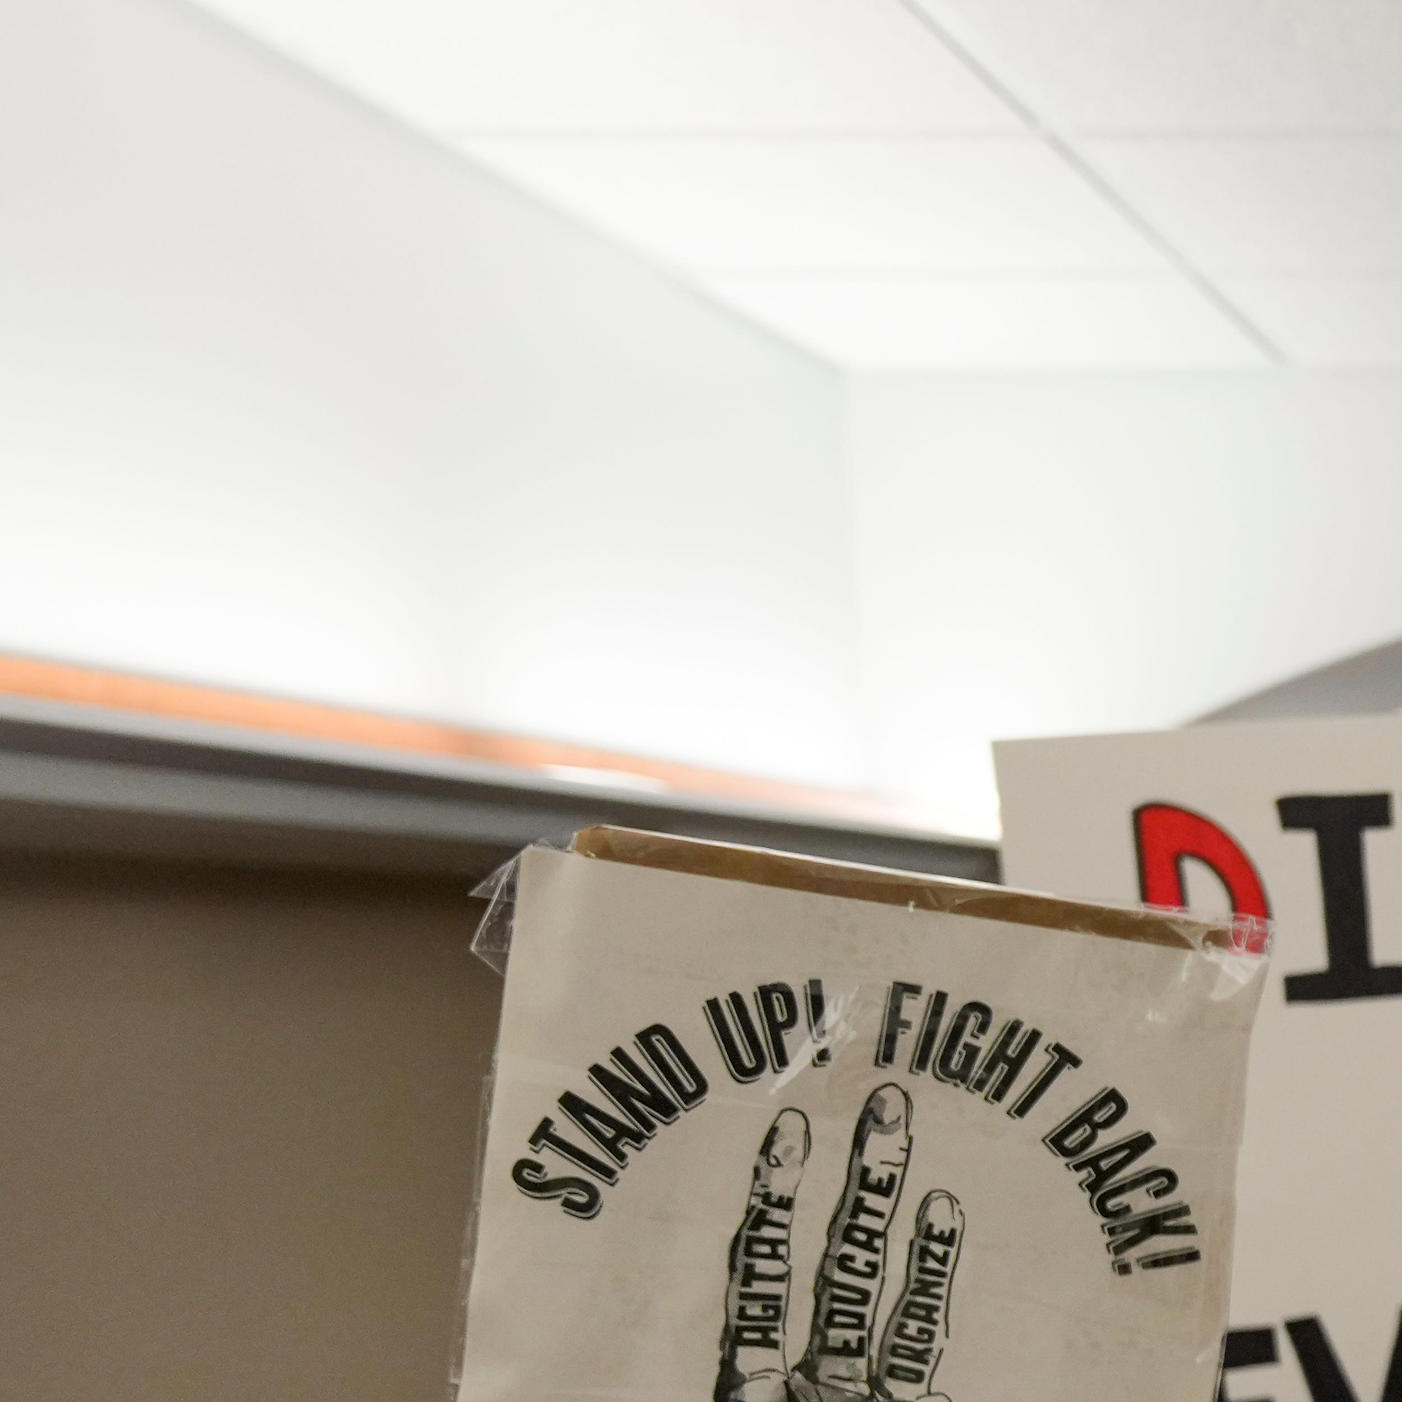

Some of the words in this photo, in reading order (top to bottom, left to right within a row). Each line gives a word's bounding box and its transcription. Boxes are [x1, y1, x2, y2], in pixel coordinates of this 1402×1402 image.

[511, 1022, 708, 1222] STAND
[703, 978, 831, 1083] UP!
[873, 980, 1083, 1120] FIGHT
[1041, 1085, 1201, 1276] BACK!
[734, 1192, 794, 1350] AGITATE
[823, 1164, 897, 1358] EDUCATE
[886, 1222, 957, 1384] ORGANIZE
